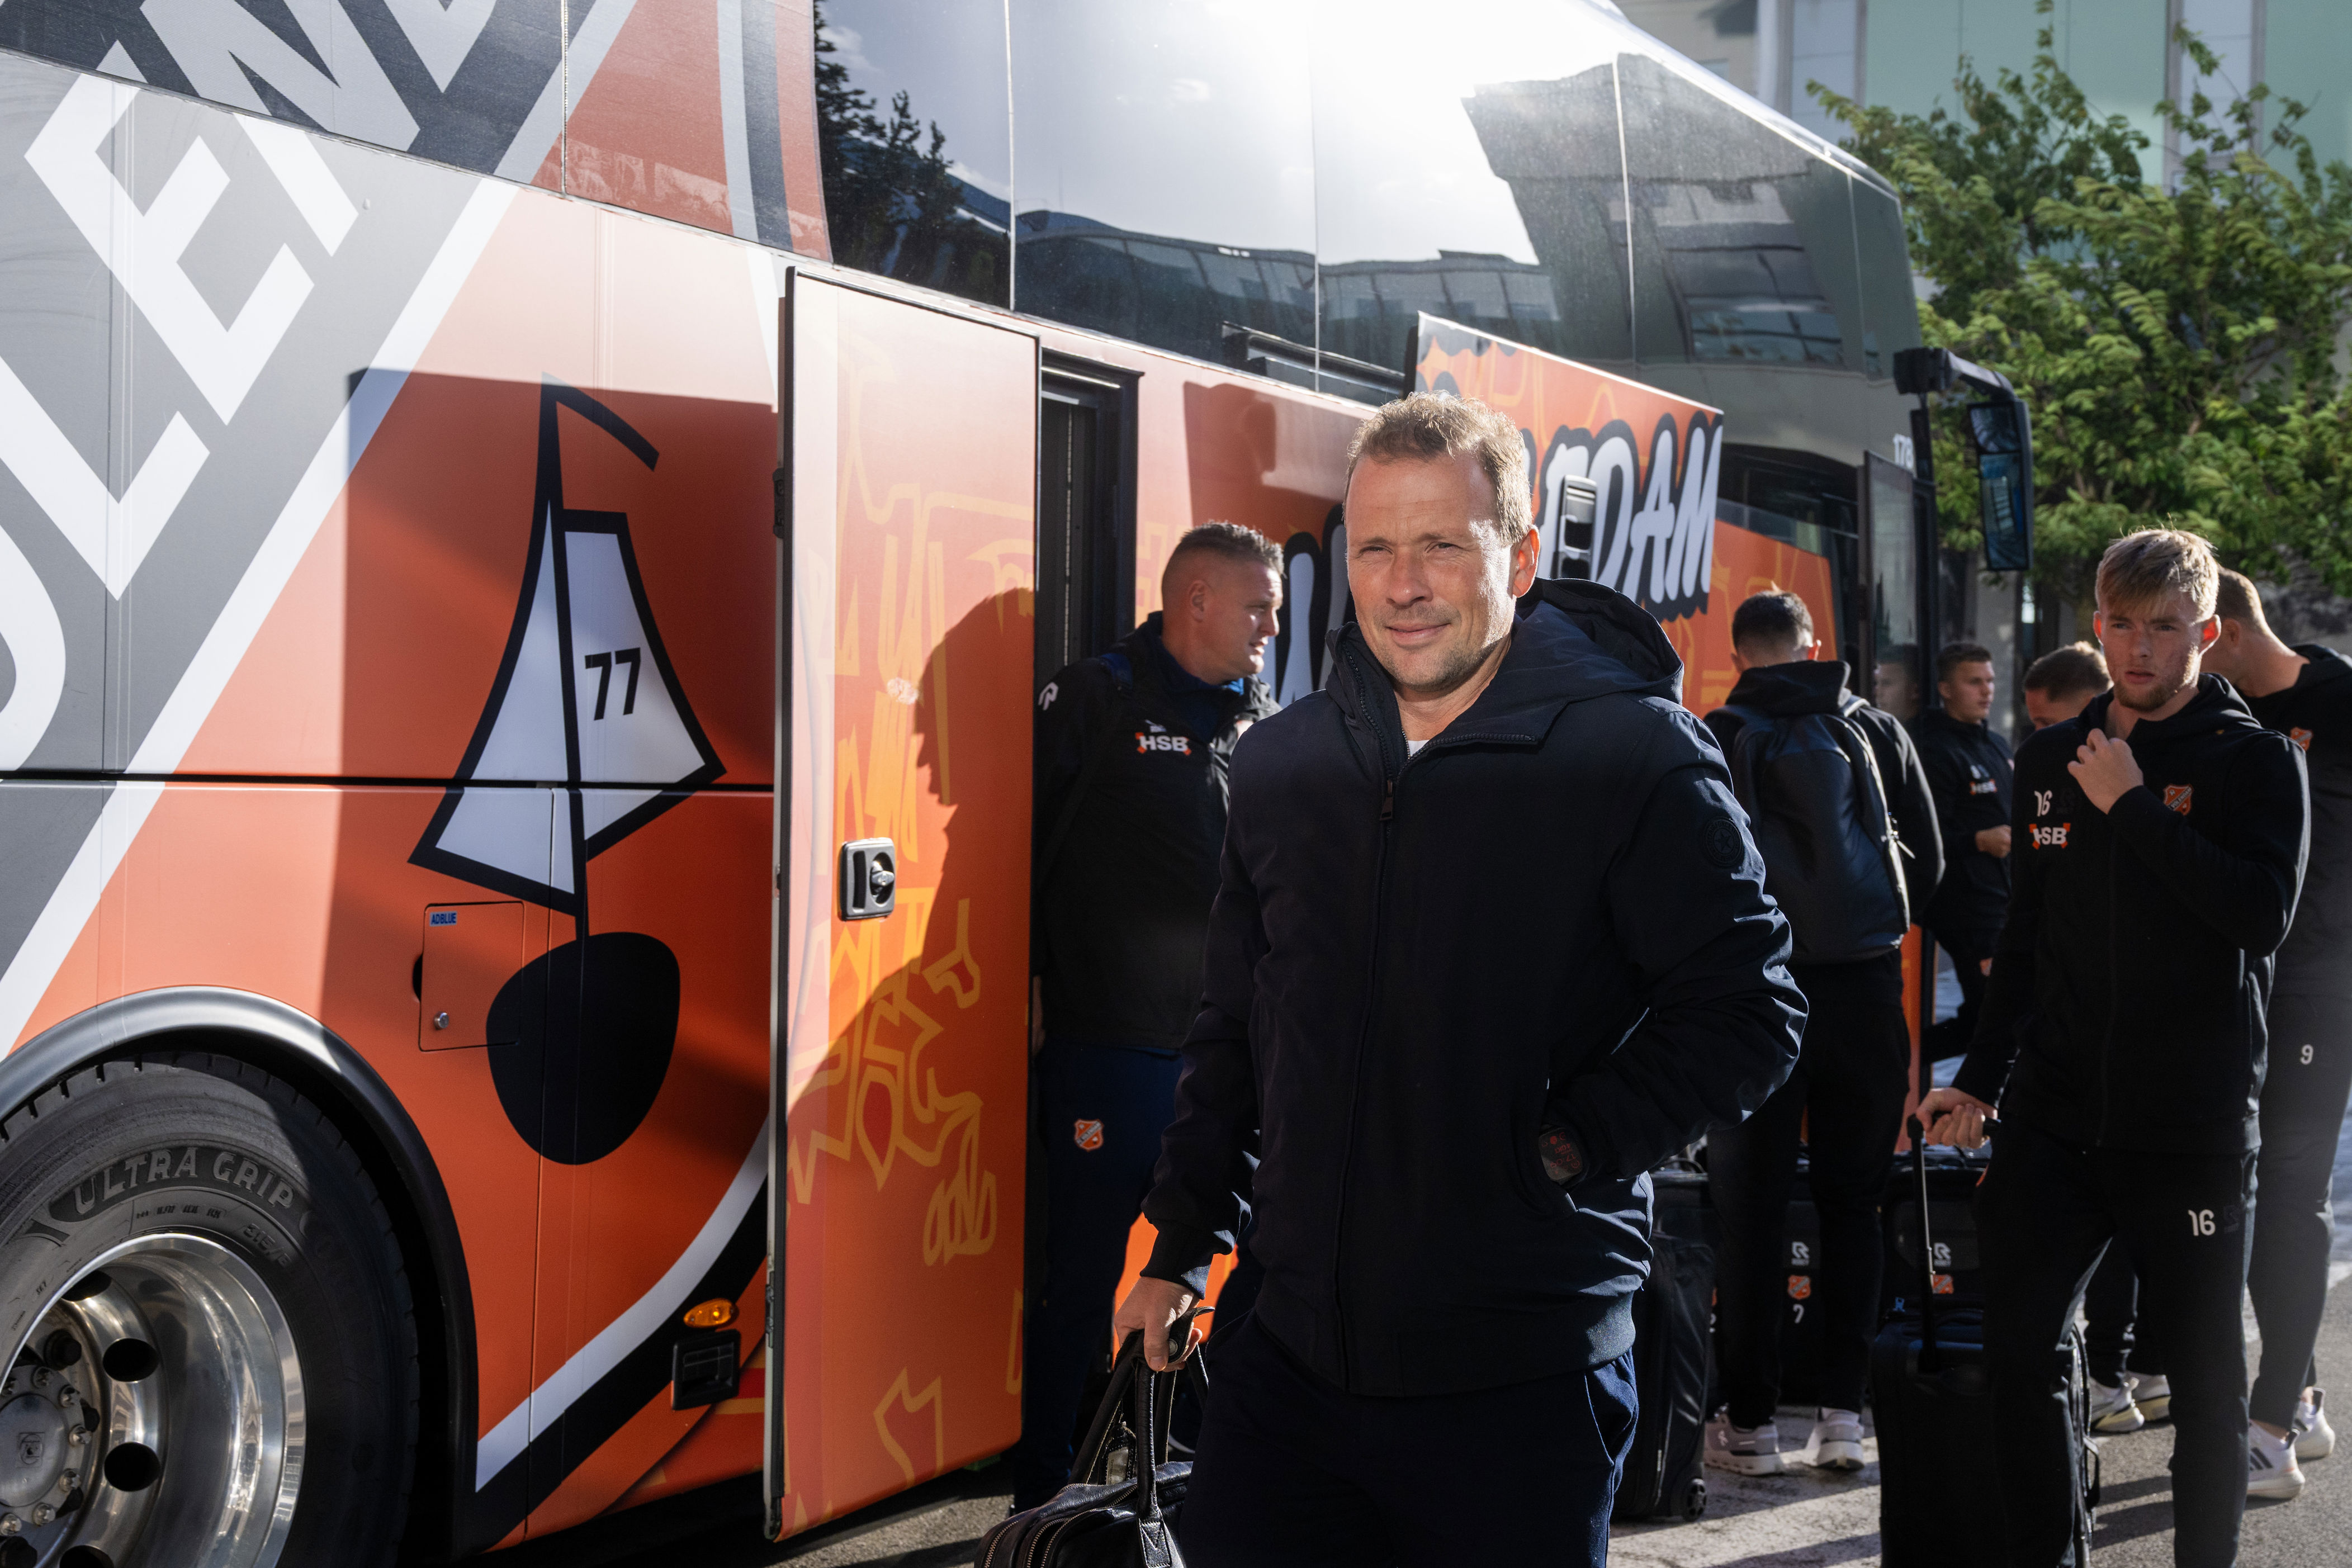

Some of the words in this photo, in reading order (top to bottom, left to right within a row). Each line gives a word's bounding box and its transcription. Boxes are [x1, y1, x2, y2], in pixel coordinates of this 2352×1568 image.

[585, 647, 641, 721] 77
[1139, 735, 1188, 752] HSB
[2034, 790, 2052, 817] 16
[430, 912, 457, 925] ADBLUE
[2300, 1044, 2313, 1065] 9
[73, 1147, 198, 1215] ULTRA
[213, 1151, 295, 1209] GRIP
[2188, 1209, 2216, 1236] 16
